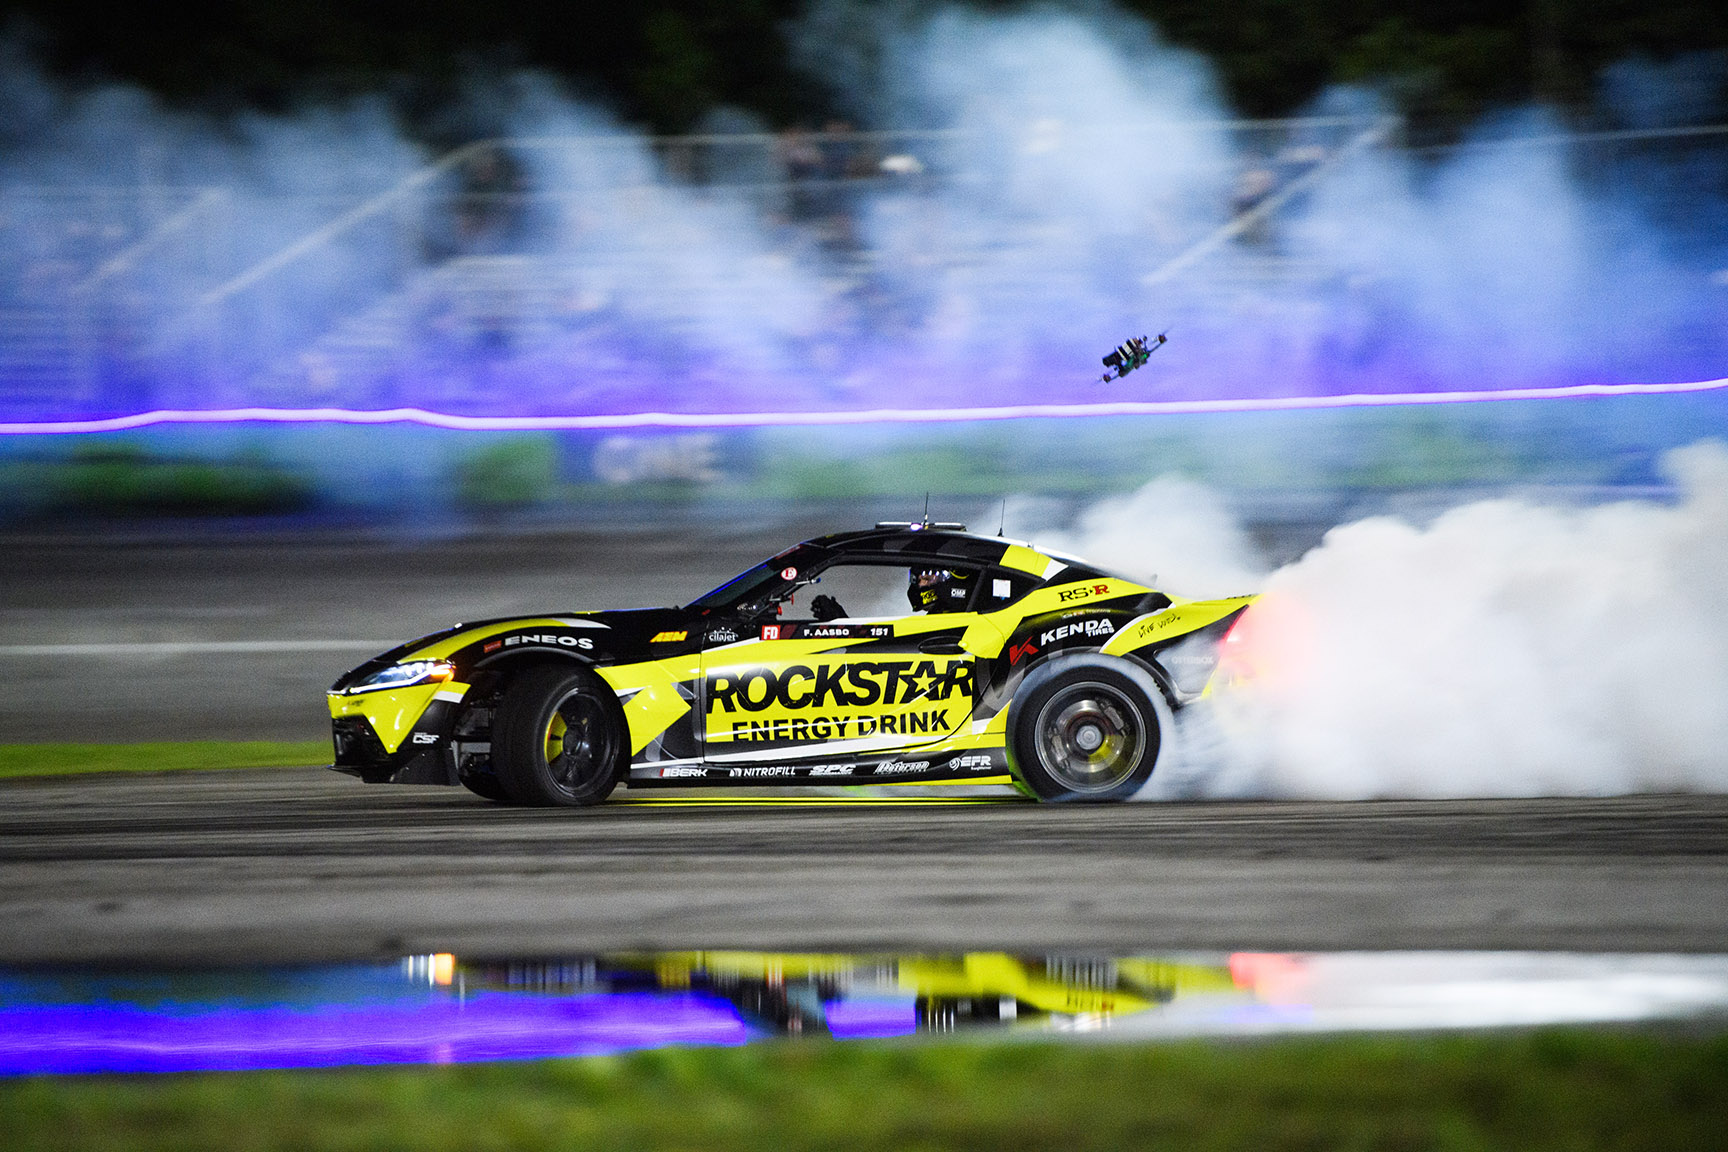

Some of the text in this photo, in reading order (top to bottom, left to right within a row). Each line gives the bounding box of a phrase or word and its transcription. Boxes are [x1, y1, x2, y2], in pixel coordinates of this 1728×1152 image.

[650, 631, 688, 643] AEM
[763, 627, 778, 639] FD
[803, 628, 850, 637] F. AASBO
[870, 628, 888, 636] 151
[1040, 618, 1113, 646] KENDA
[1086, 626, 1115, 637] TIRES
[505, 635, 594, 650] ENEOS
[706, 660, 974, 714] ROCKSTAR
[732, 708, 951, 742] ENERGY DRINK
[412, 734, 440, 744] CSF
[960, 755, 992, 767] EFR
[670, 768, 708, 777] BERK
[743, 766, 796, 778] NITROFILL
